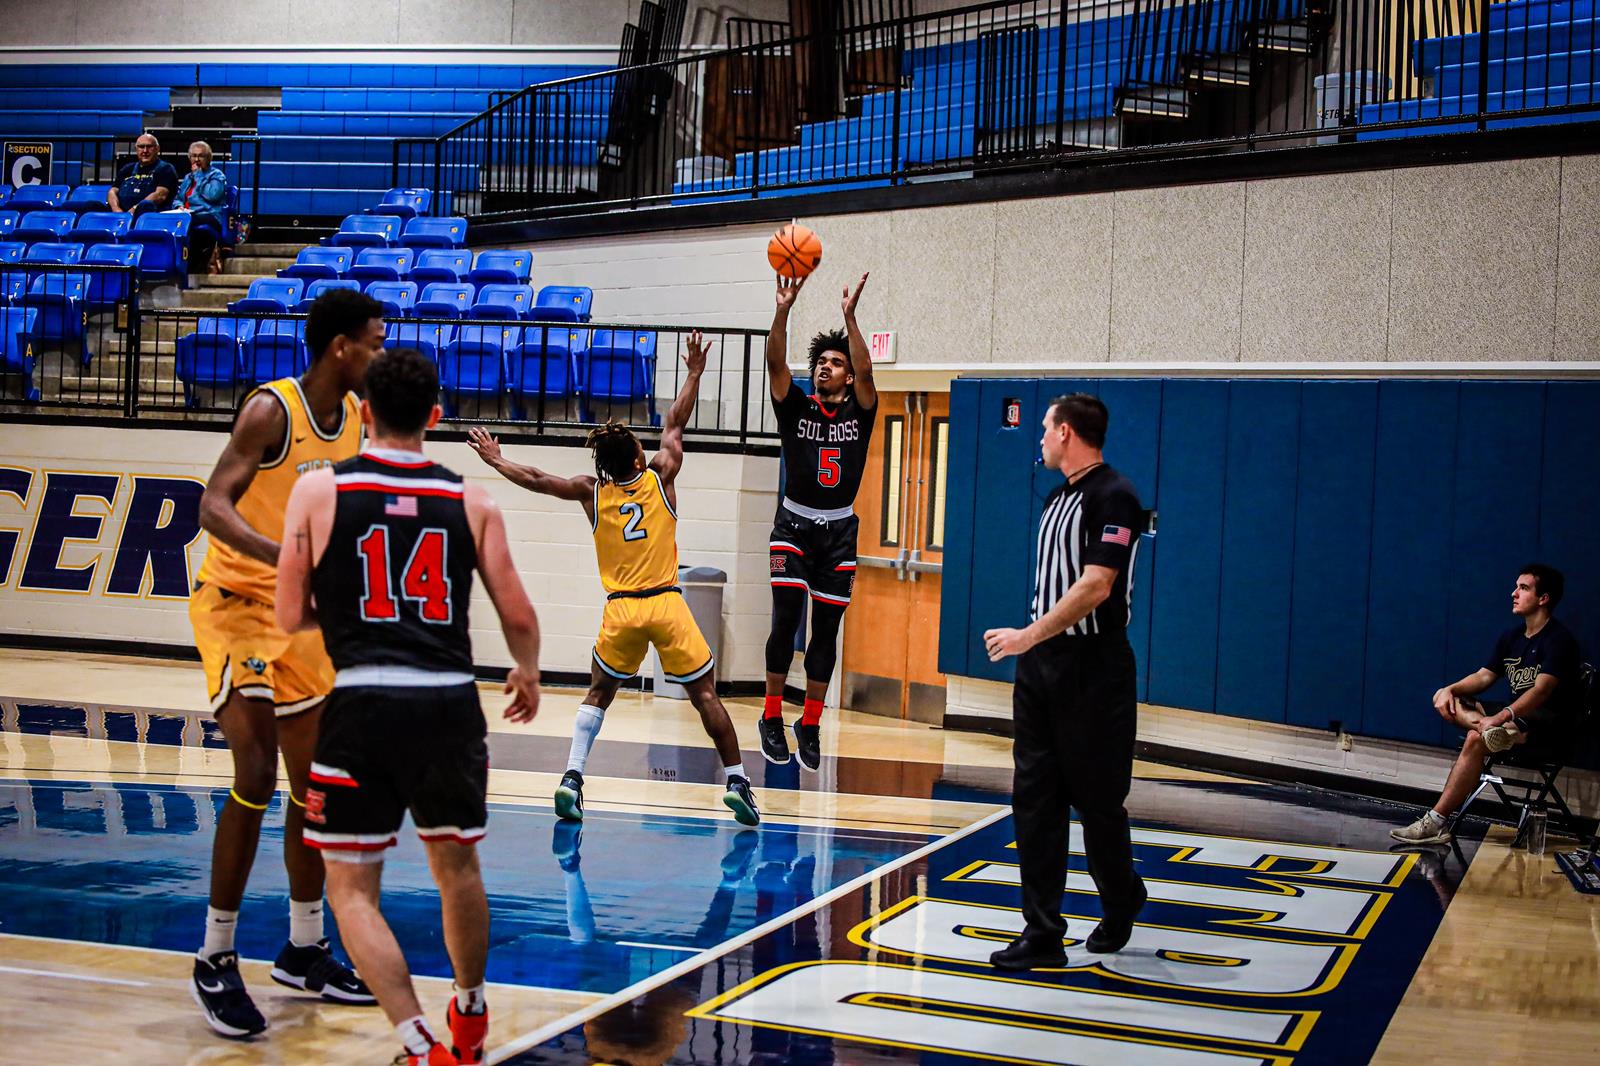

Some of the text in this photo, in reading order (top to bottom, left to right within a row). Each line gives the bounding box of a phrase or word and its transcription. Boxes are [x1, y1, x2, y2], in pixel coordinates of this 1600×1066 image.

[14, 145, 50, 154] SECTION
[12, 155, 42, 190] C
[25, 342, 34, 358] A
[871, 332, 891, 357] EXIT
[797, 418, 860, 443] SUL ROSS
[817, 446, 842, 489] 5
[619, 501, 649, 543] 2
[356, 523, 453, 625] 14
